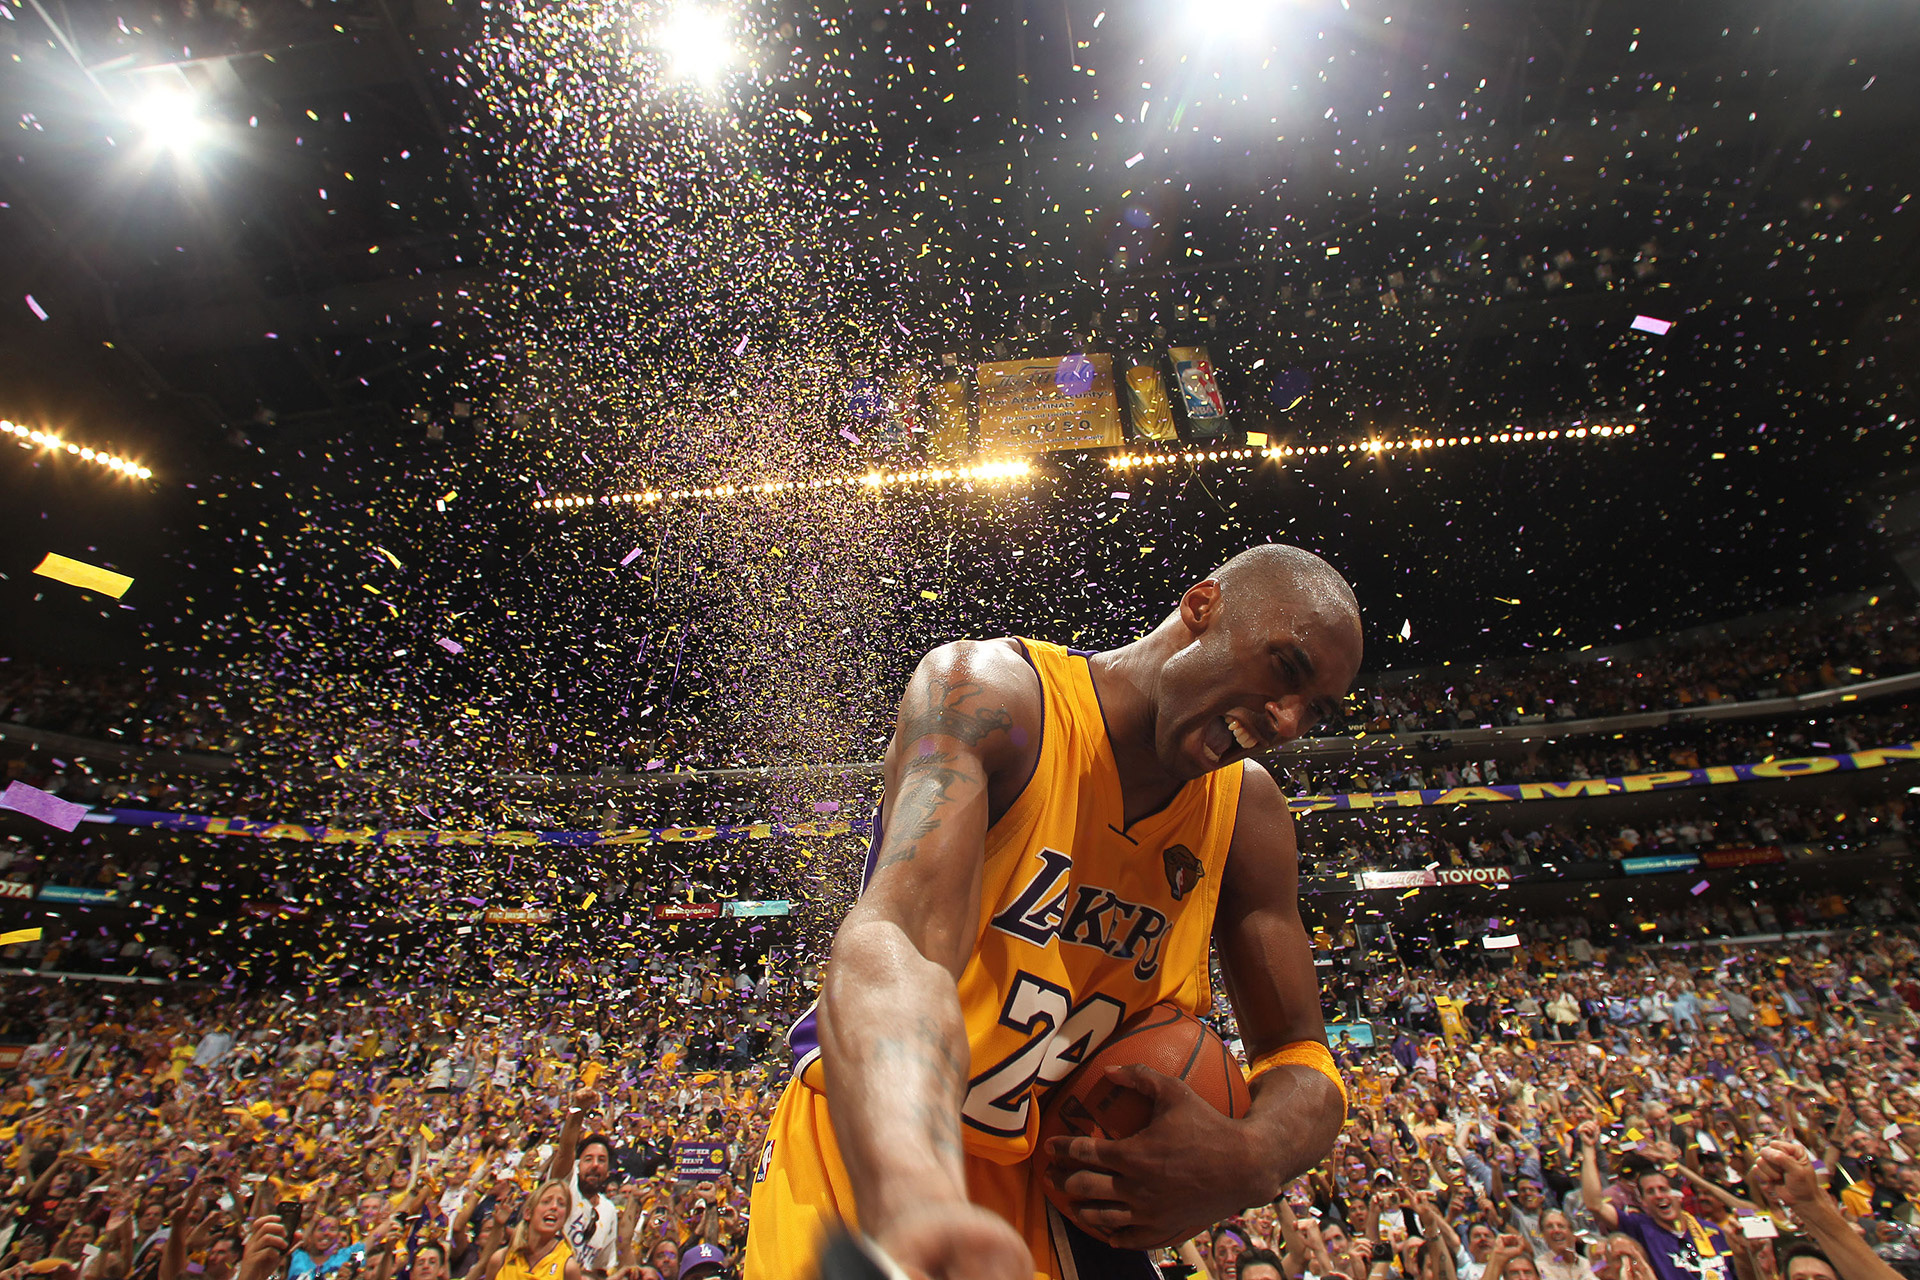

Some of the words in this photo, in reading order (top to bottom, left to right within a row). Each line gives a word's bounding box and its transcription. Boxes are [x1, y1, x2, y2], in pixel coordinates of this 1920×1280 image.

[1438, 867, 1511, 884] TOYOTA
[962, 969, 1126, 1137] 24
[700, 1243, 712, 1257] LA
